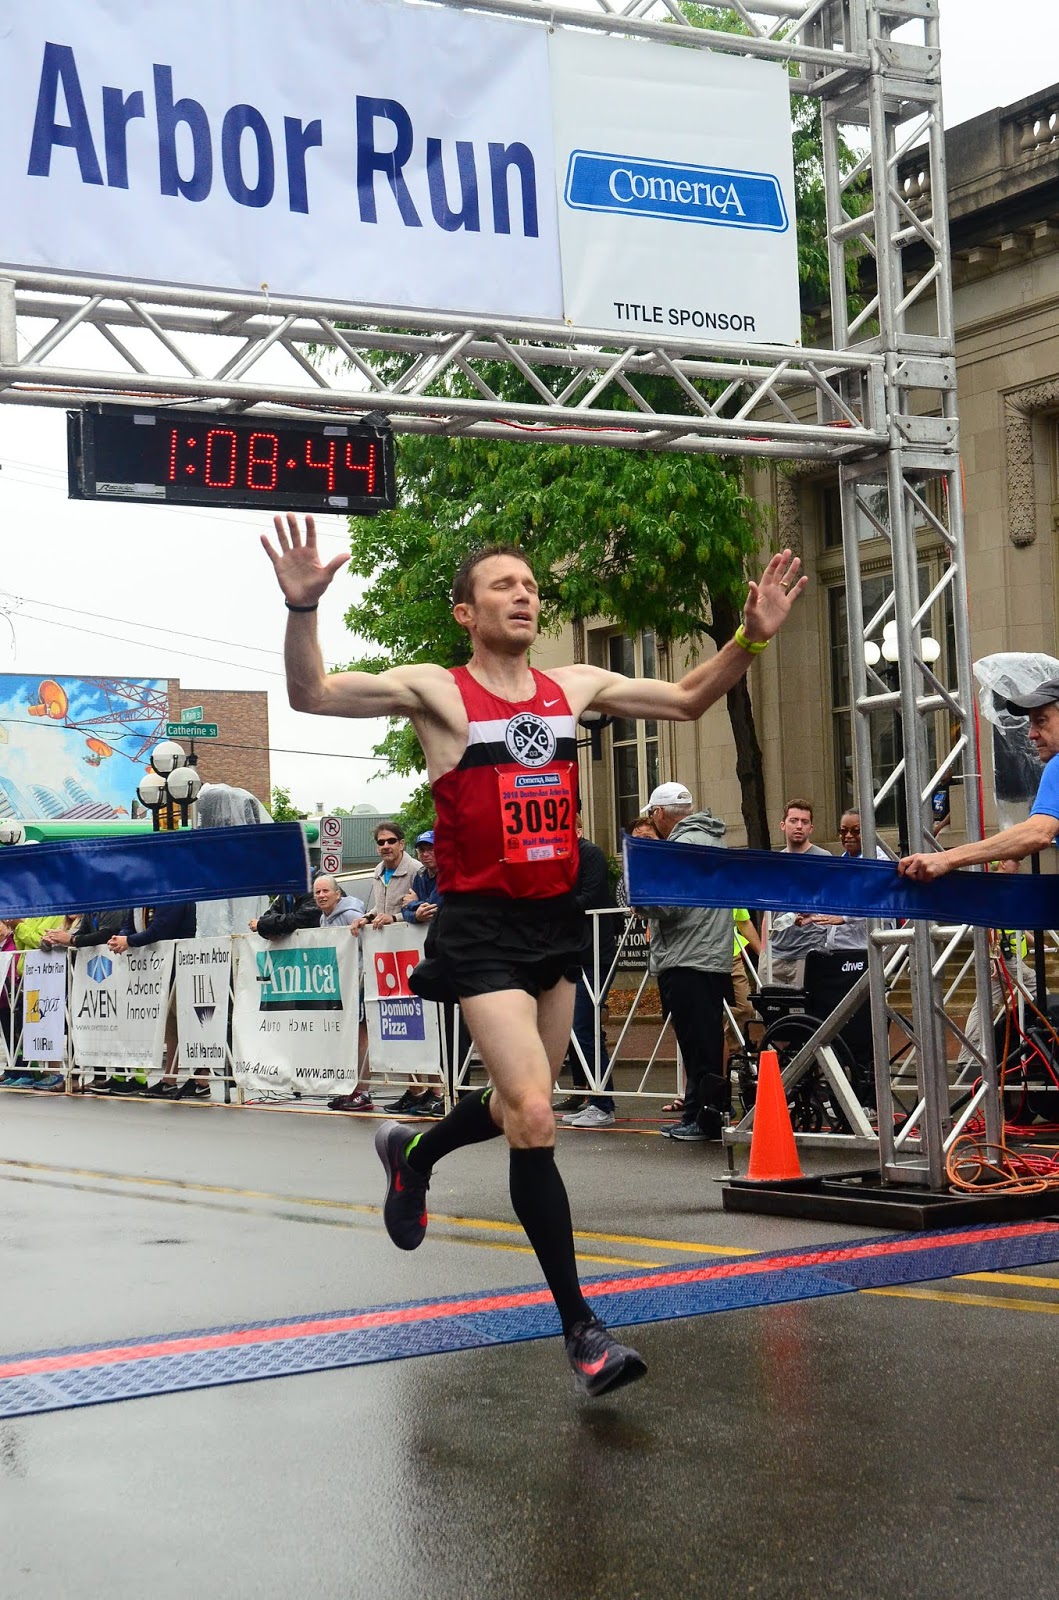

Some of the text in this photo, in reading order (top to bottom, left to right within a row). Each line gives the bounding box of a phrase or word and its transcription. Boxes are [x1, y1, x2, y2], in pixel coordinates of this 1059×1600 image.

[27, 41, 539, 238] Arbor Run
[613, 302, 756, 332] TITLE SPONSOR
[167, 726, 216, 736] Catherine St
[524, 723, 532, 734] T
[515, 736, 525, 747] B
[538, 734, 548, 745] C
[504, 797, 571, 835] 3092
[126, 951, 164, 971] Toos for
[211, 947, 230, 963] Arbor
[262, 951, 336, 995] Amica
[77, 989, 117, 1018] AVEN
[381, 1000, 421, 1016] Domino's
[382, 1018, 407, 1035] Pizza
